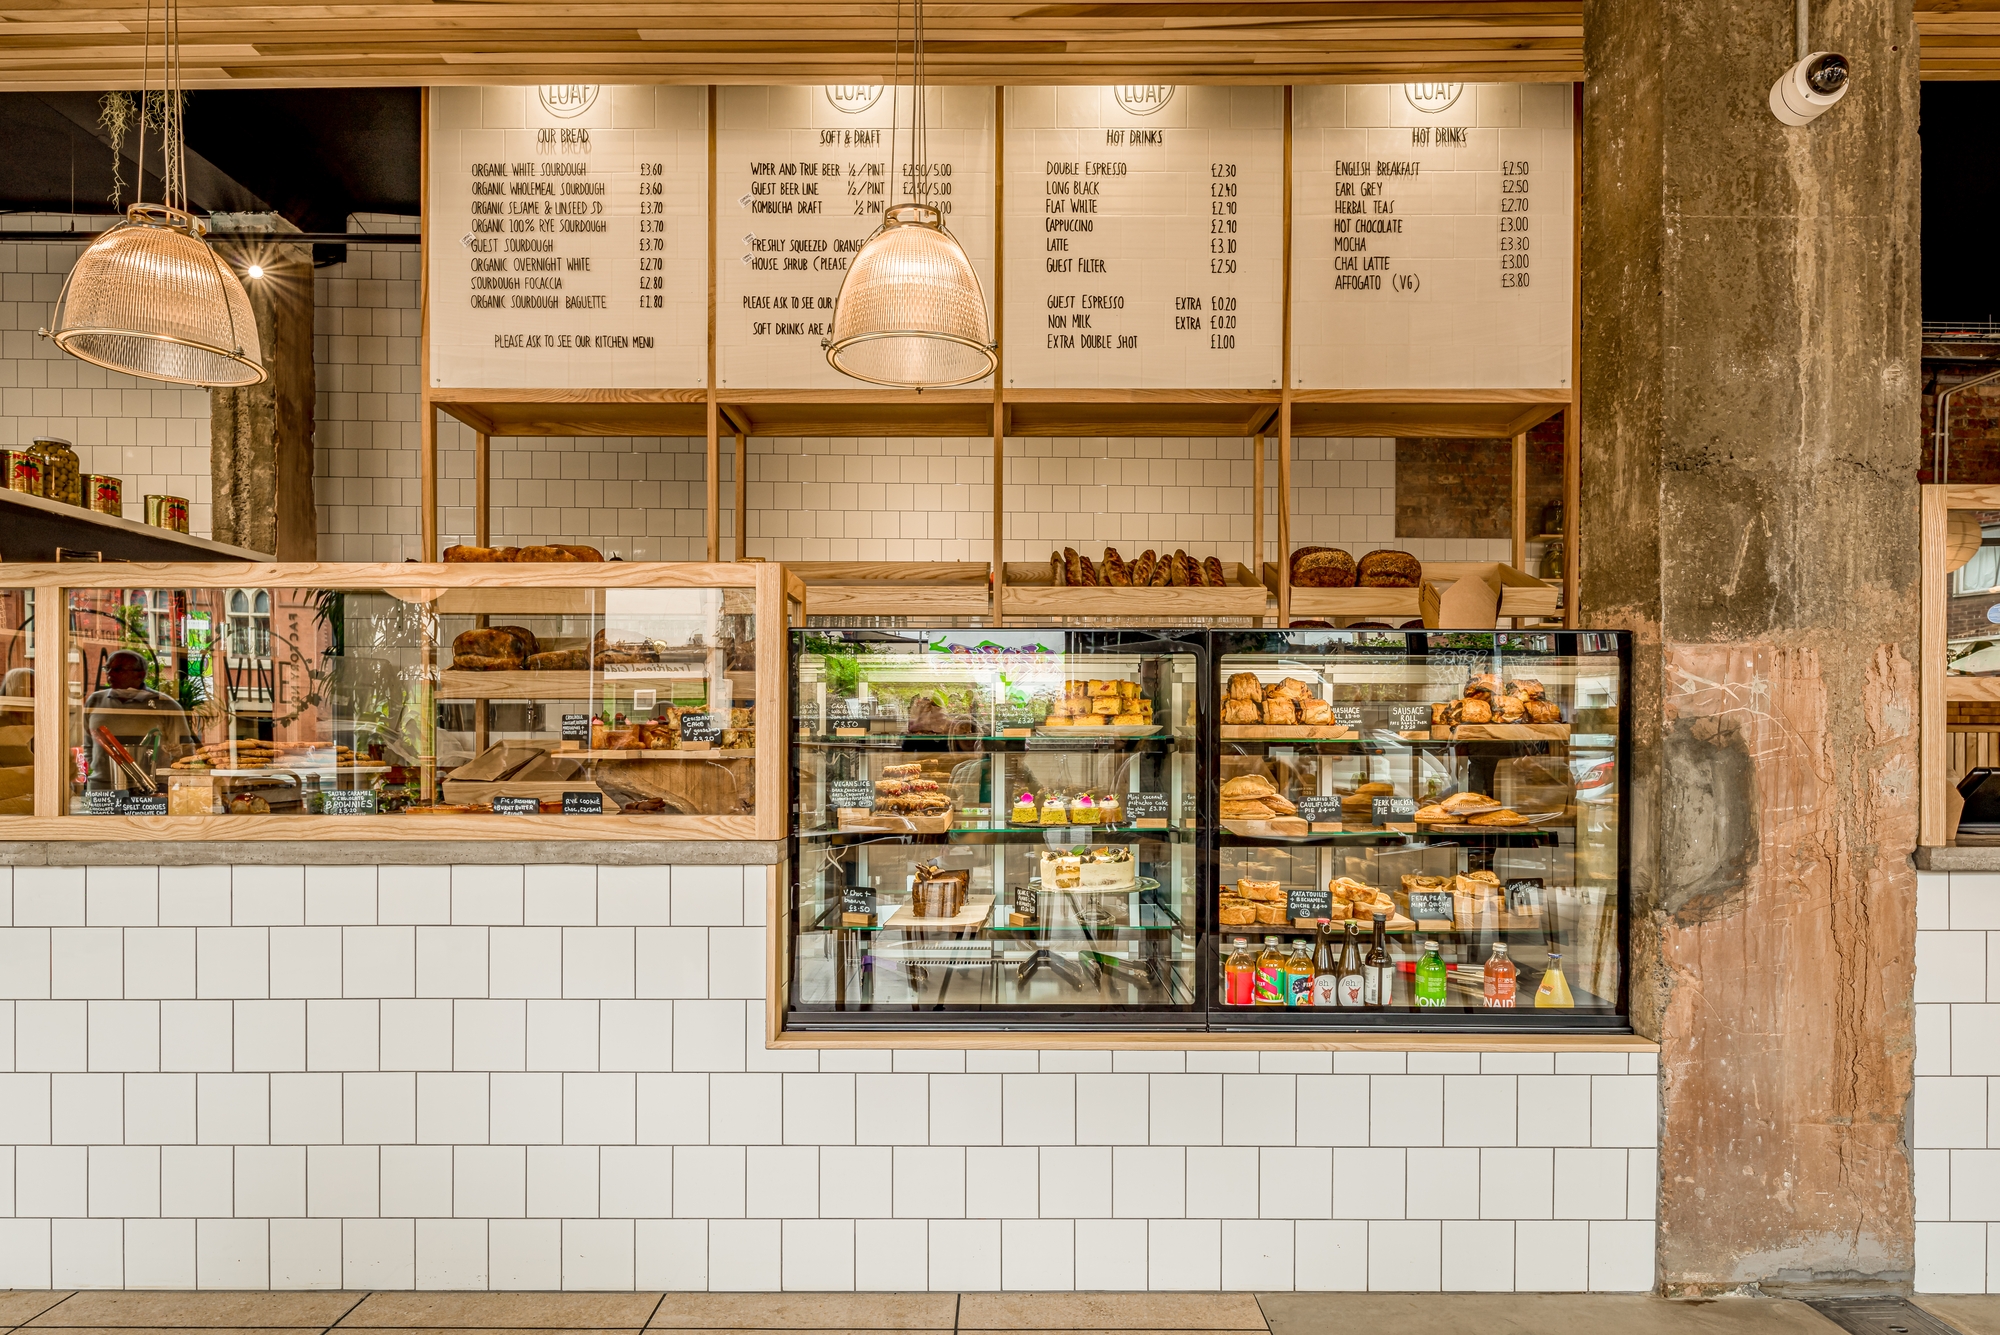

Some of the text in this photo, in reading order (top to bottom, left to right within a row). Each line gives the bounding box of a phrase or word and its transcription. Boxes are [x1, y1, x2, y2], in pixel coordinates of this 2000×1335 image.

[538, 129, 589, 143] OUR BREAD
[820, 130, 881, 144] SOFT & DRAFT
[1107, 130, 1162, 144] HOT DRINKS
[1412, 128, 1466, 142] HOT DRINKS
[472, 163, 662, 177] ORGANIC WHITE SOURDOUGH £3.60
[751, 162, 776, 177] WIPER
[779, 163, 797, 177] AND
[799, 162, 818, 176] TRUE
[822, 163, 840, 176] BEER
[902, 162, 951, 177] £250/5.00
[1047, 161, 1236, 177] DOUBLE ESPRESSO £2.30
[1336, 160, 1529, 176] ENGLISH BREAKFAST £2.50
[472, 182, 662, 196] ORGANIC WHOLEMEAL SOURDOUGH £3.60
[751, 181, 776, 196] GUEST
[781, 182, 800, 195] BEER
[802, 183, 819, 195] LINE
[903, 182, 951, 196] £250/5.00
[1047, 181, 1237, 197] LONG BLACK £2.40
[1336, 180, 1528, 196] EARL GREY £2.50
[471, 201, 663, 215] ORGANIC SESAME & LINSEED SD £3.70
[751, 200, 792, 214] KOMBUCHA
[798, 201, 822, 214] DRAFT
[867, 200, 884, 214] PINT
[1046, 199, 1237, 215] FLAT WHITE £2.90
[1335, 198, 1528, 214] HERBAL TEAS £2.70
[471, 219, 664, 233] ORGANIC 100% RYE SOURDOUGH £3.70
[1046, 217, 1237, 233] CAPPUCCINO £2.90
[1335, 217, 1528, 233] HOT CHOCOLATE £3.00
[471, 238, 498, 252] GUEST
[504, 238, 553, 252] SOURDOUGH
[639, 238, 664, 251] £3.70
[751, 239, 785, 252] FRESHLY
[789, 239, 827, 253] SQUEEZED
[1047, 238, 1236, 253] LATTE £3.10
[1335, 237, 1529, 251] MOCHA £3.30
[471, 257, 662, 271] ORGANIC OVERNIGHT WHITE £2.70
[751, 256, 779, 270] HOUSE
[783, 257, 808, 270] SHRUB
[1047, 257, 1236, 273] GUEST FILTER £2.50
[1335, 254, 1529, 271] CHAI LATTE £3.00
[471, 276, 663, 289] SOURDOUGH FOCACCIA £2.80
[1335, 273, 1529, 292] AFFOGATO (VG) £3.80
[471, 295, 663, 309] ORGANIC SOURDOUGH BAGUETTE £1.80
[743, 296, 770, 309] PLEASE
[773, 297, 788, 309] ASK
[791, 296, 799, 309] TO
[801, 297, 814, 309] SEE
[818, 297, 833, 309] OUR
[1047, 294, 1236, 311] GUEST ESPRESSO EXTRA £0.20
[753, 322, 771, 335] SOFT
[776, 323, 804, 335] DRINKS
[808, 323, 824, 335] ARE
[1048, 314, 1236, 330] NON MILK EXTRA £0.20
[495, 334, 654, 348] PLEASE ASK TO SEE OUR KITCHEN MENU
[1047, 334, 1235, 349] EXTRA DOUBLE SHOT £1.00
[1393, 707, 1424, 715] SAUSAGE
[142, 803, 166, 811] COOKIES
[326, 800, 373, 809] BROWNIES
[1377, 807, 1387, 815] PIE
